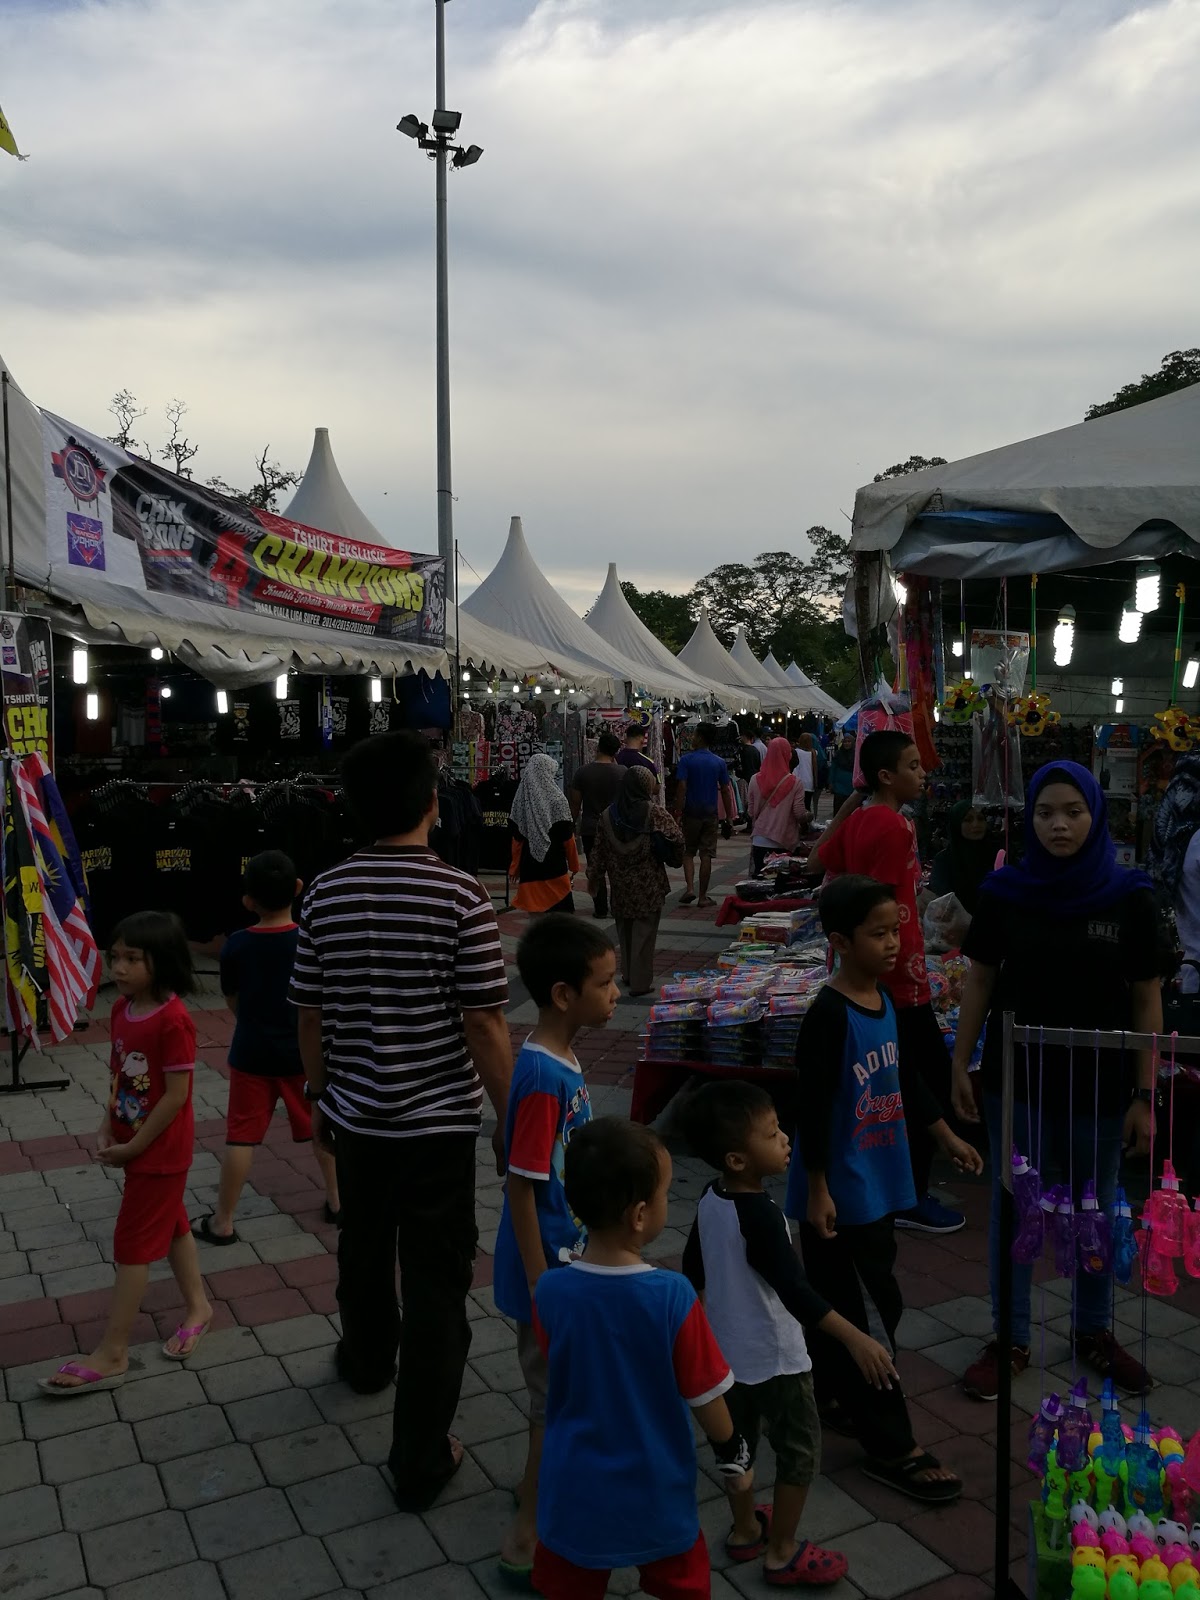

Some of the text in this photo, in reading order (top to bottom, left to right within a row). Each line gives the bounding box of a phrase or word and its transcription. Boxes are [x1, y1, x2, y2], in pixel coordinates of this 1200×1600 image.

[292, 527, 334, 554] TSHIRT
[252, 533, 425, 613] CHAMPIONS
[273, 605, 290, 620] PIALA
[290, 609, 304, 622] LIGA
[303, 612, 321, 626] SUPER
[4, 694, 36, 705] TSHIRT
